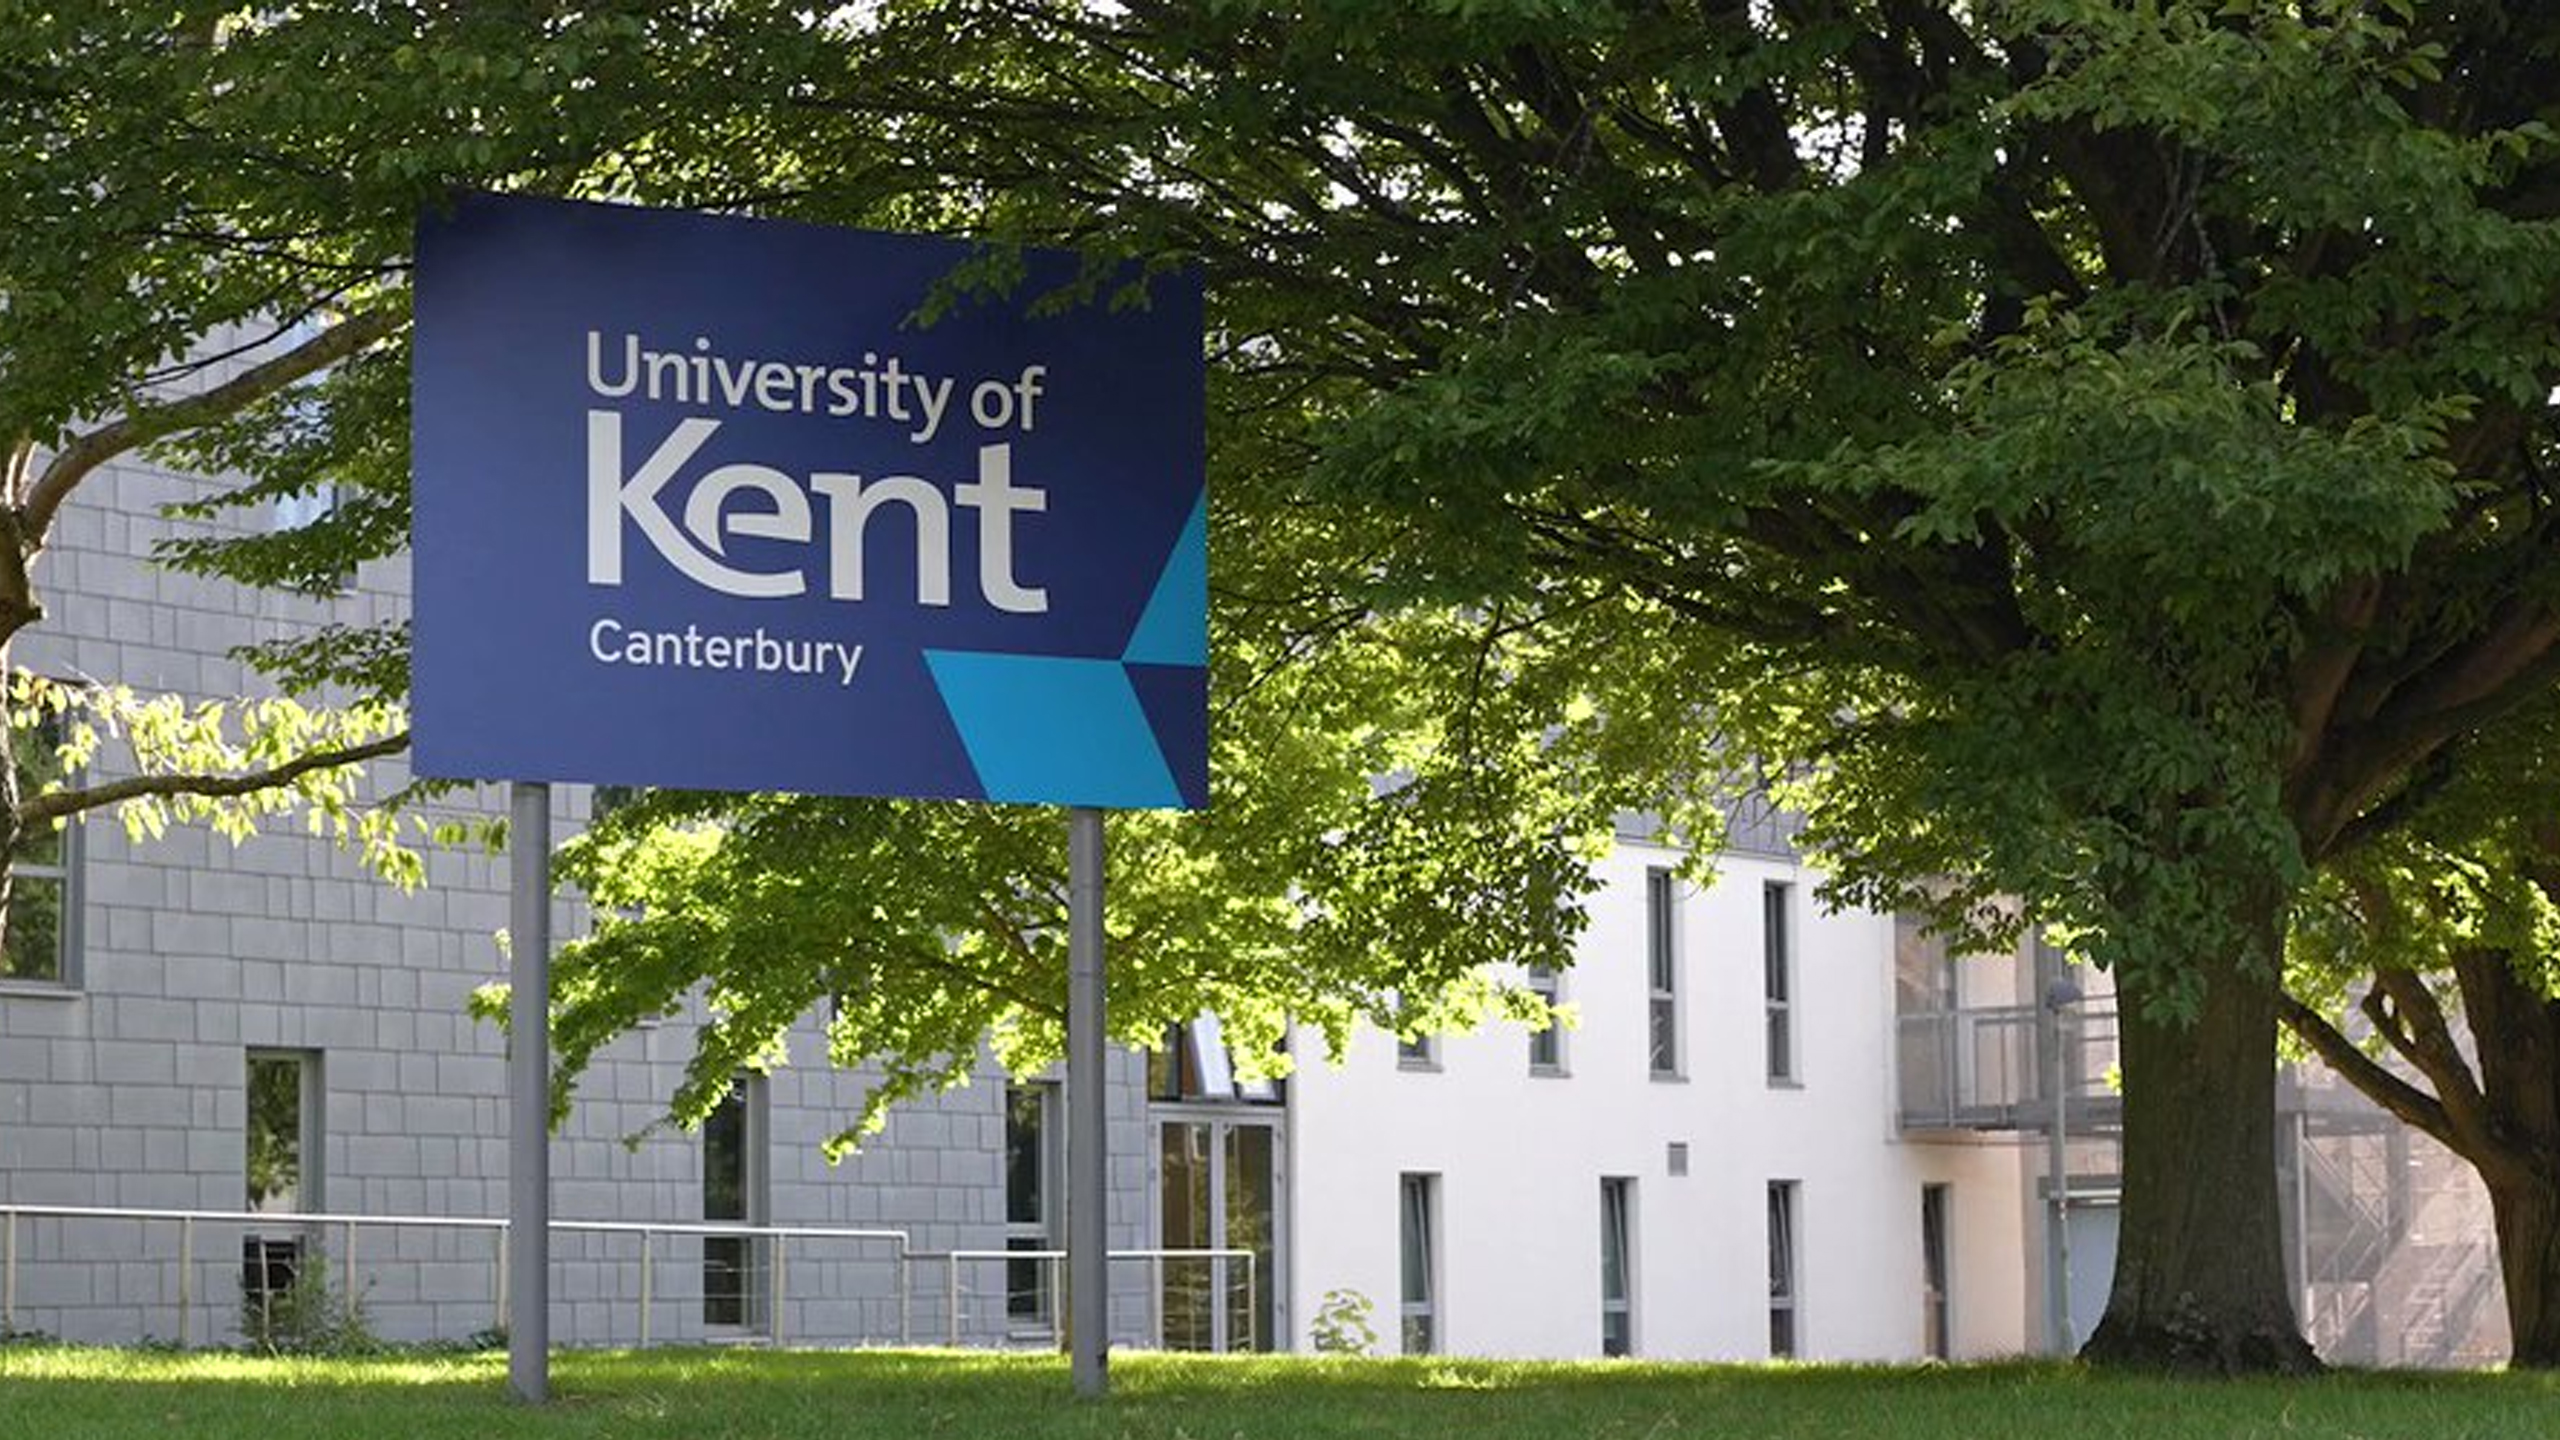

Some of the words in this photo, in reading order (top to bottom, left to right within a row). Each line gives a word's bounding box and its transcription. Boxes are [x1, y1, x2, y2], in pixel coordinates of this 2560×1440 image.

[587, 331, 953, 443] University
[971, 366, 1047, 430] of
[587, 409, 1048, 613] Kent
[590, 618, 863, 685] Canterbury
